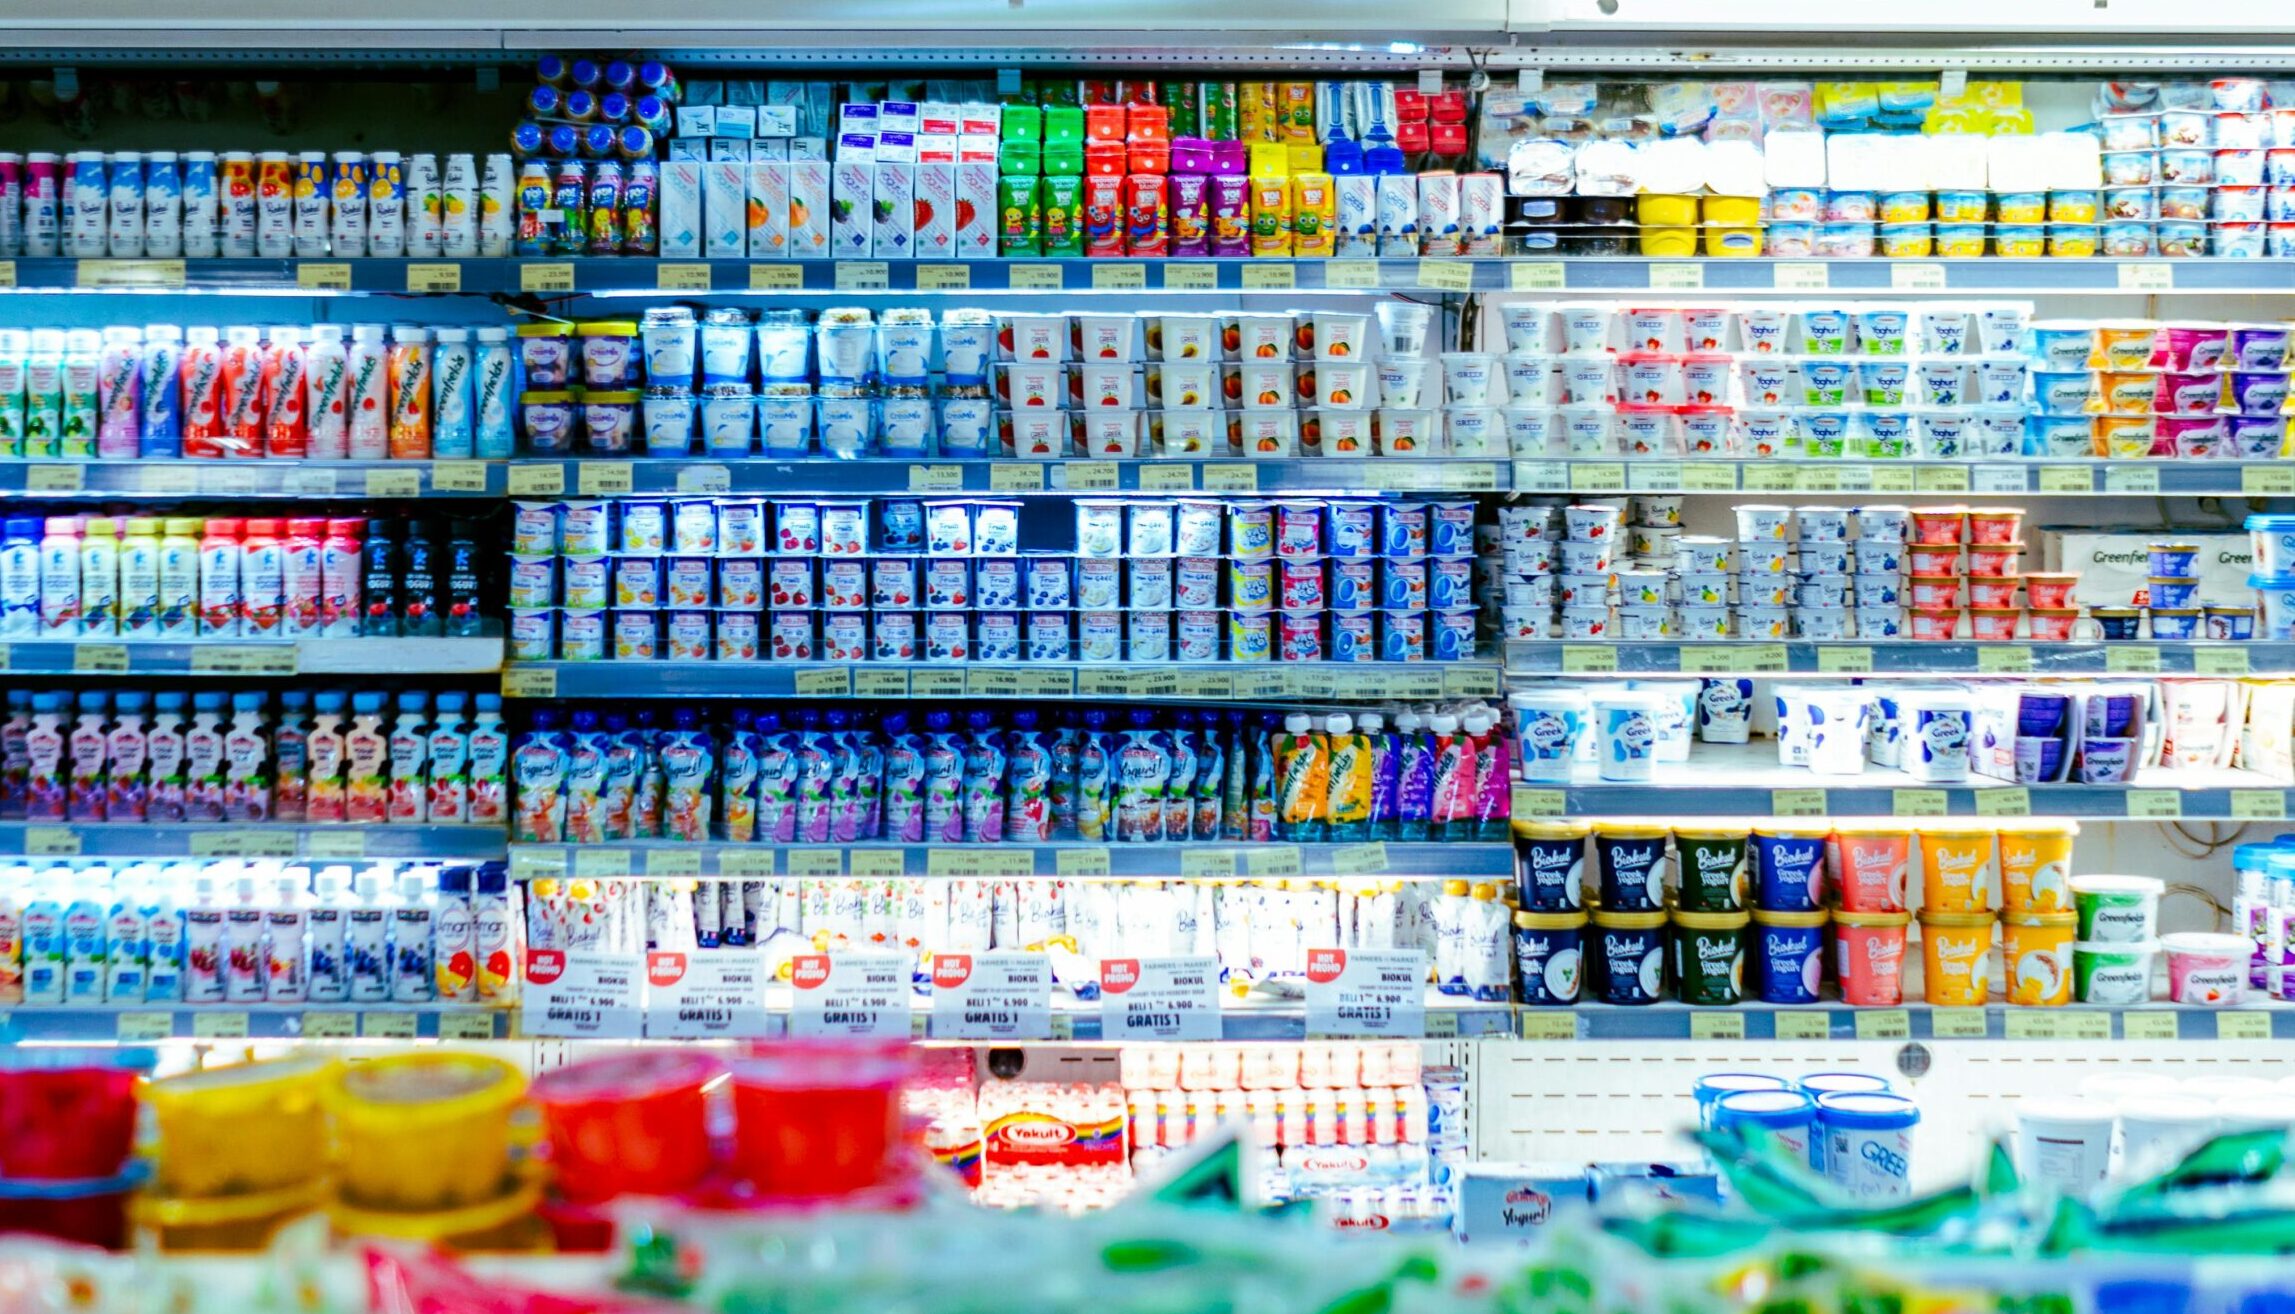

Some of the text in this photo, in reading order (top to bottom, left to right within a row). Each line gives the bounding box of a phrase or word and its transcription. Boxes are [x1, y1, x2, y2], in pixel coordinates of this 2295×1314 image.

[1531, 846, 1571, 869] Biokul
[1611, 846, 1651, 869] Biokul
[1695, 846, 1736, 869] Biokul
[1773, 845, 1814, 867] Biokul
[1853, 846, 1893, 869] Biokul
[1935, 848, 1977, 870] Biokul
[1605, 935, 1644, 958] Biokul
[1696, 937, 1736, 958] Biokul
[1768, 934, 1808, 956] Biokul
[1936, 937, 1977, 959] Biokul
[598, 976, 629, 986] BIOKUL
[722, 975, 753, 983] BIOKUL
[866, 975, 897, 983] BIOKUL
[1008, 975, 1038, 983] BIOKUL
[1173, 976, 1204, 986] BIOKUL
[1381, 973, 1412, 982] BIOKUL
[590, 997, 616, 1006] 6.900
[717, 996, 743, 1005] 6.900
[861, 998, 887, 1007] 6.900
[1003, 998, 1028, 1007] 6.900
[1376, 994, 1401, 1003] 6.900
[1168, 1000, 1193, 1010] 6.900
[547, 1009, 601, 1022] GRATIS 1
[679, 1008, 732, 1021] GRATIS 1
[823, 1012, 877, 1023] GRATIS 1
[965, 1012, 1018, 1023] GRATIS 1
[1337, 1006, 1391, 1019] GRATIS 1
[1127, 1013, 1180, 1028] GRATIS 1
[1014, 1128, 1063, 1140] Yakult
[1860, 1139, 1907, 1178] GREE
[1333, 1217, 1377, 1229] Yakult
